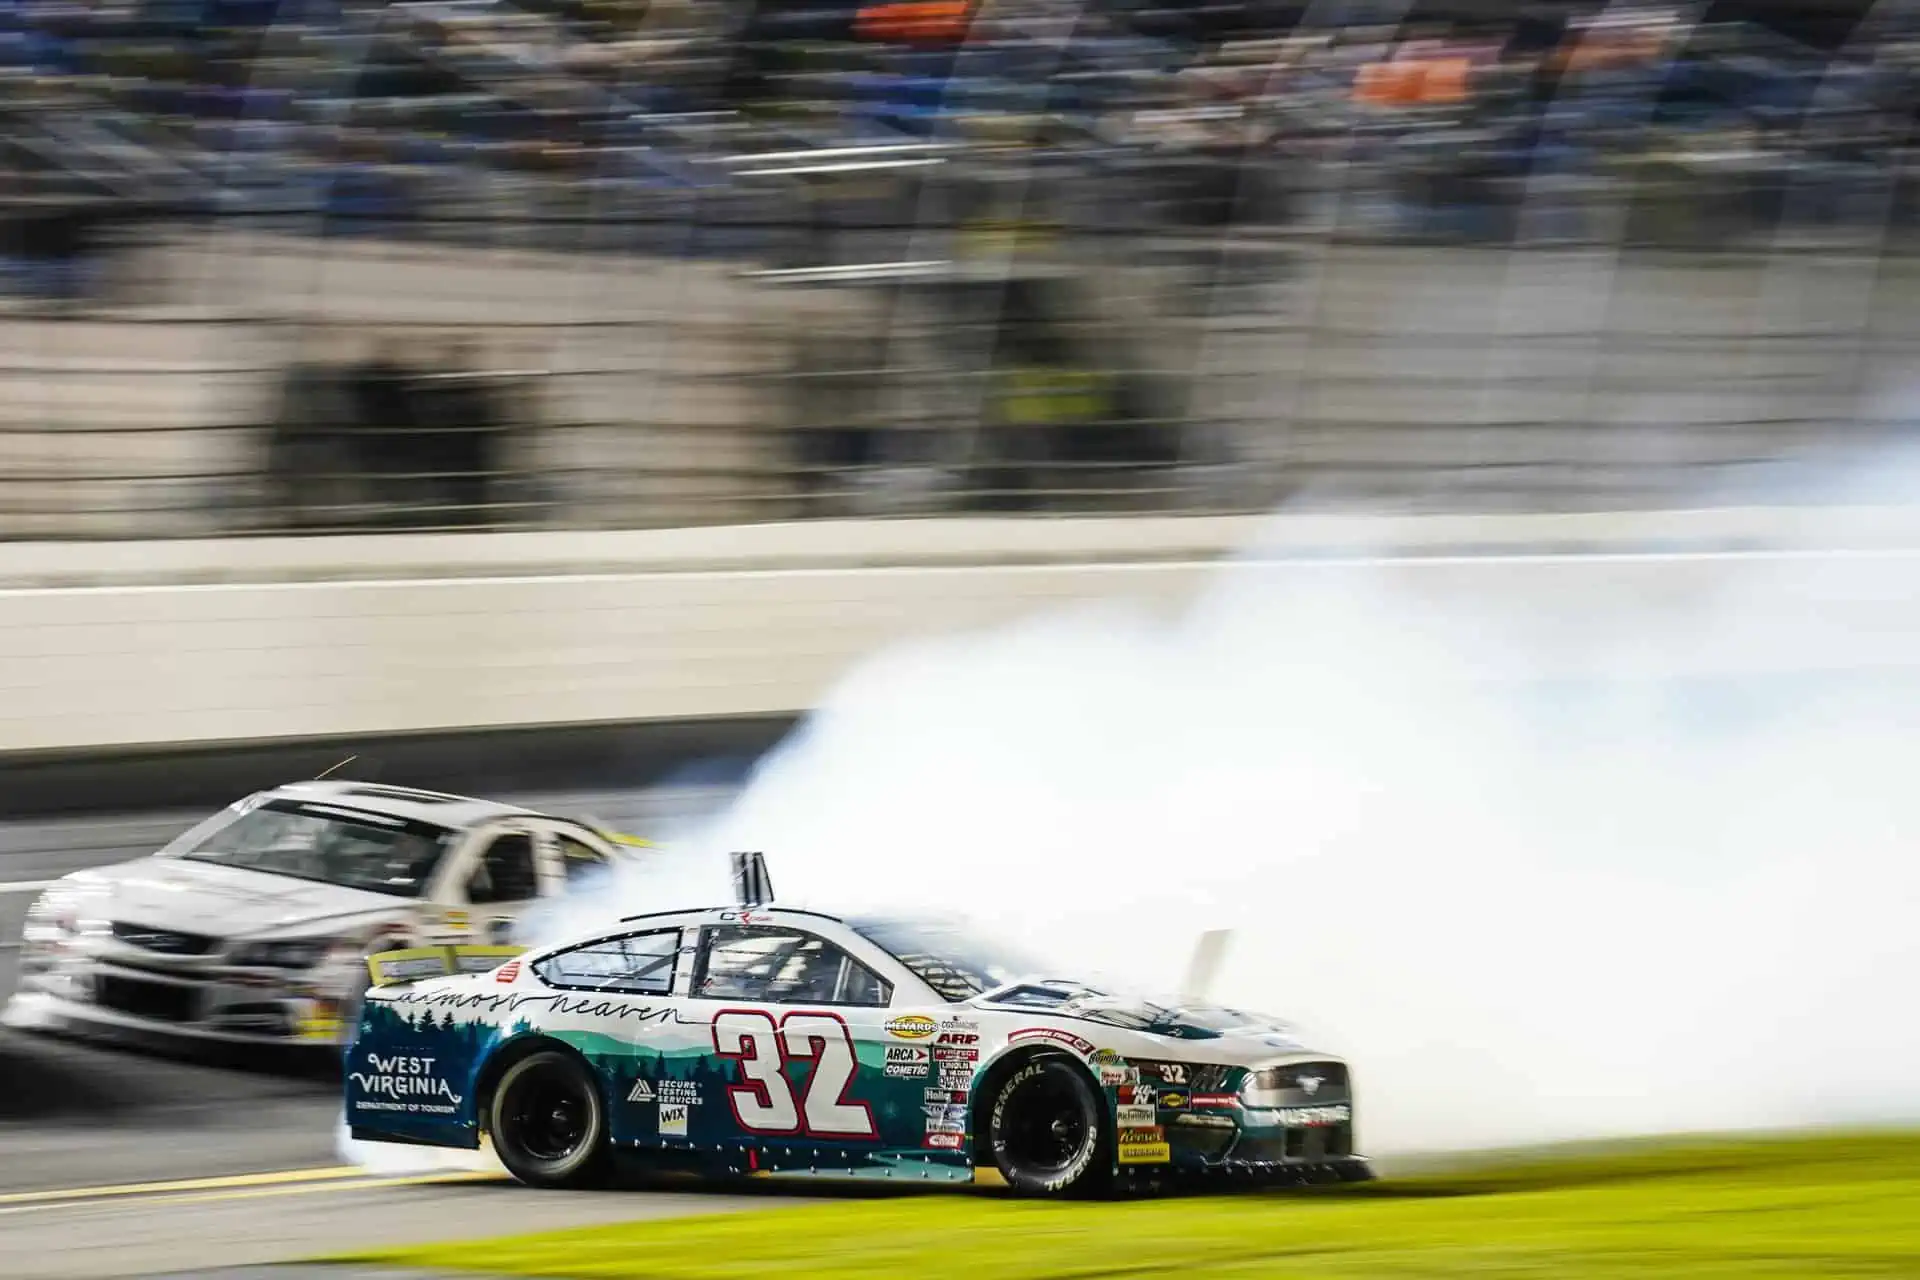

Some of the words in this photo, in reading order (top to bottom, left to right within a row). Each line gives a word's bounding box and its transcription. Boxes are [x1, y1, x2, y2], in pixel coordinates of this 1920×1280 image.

[548, 993, 685, 1025] heaven
[885, 1021, 938, 1032] MENARDS
[937, 1034, 980, 1044] ARP
[887, 1048, 914, 1061] ARCA
[367, 1053, 436, 1075] WEST
[886, 1064, 929, 1076] COMETIC
[712, 1009, 880, 1140] 32
[1159, 1064, 1187, 1084] 32
[348, 1072, 463, 1104] VIRGINIA
[658, 1080, 697, 1089] SECURE
[657, 1088, 697, 1097] TESTING
[992, 1063, 1045, 1129] GENERAL
[657, 1096, 703, 1105] SERVICES
[661, 1107, 685, 1123] WIX
